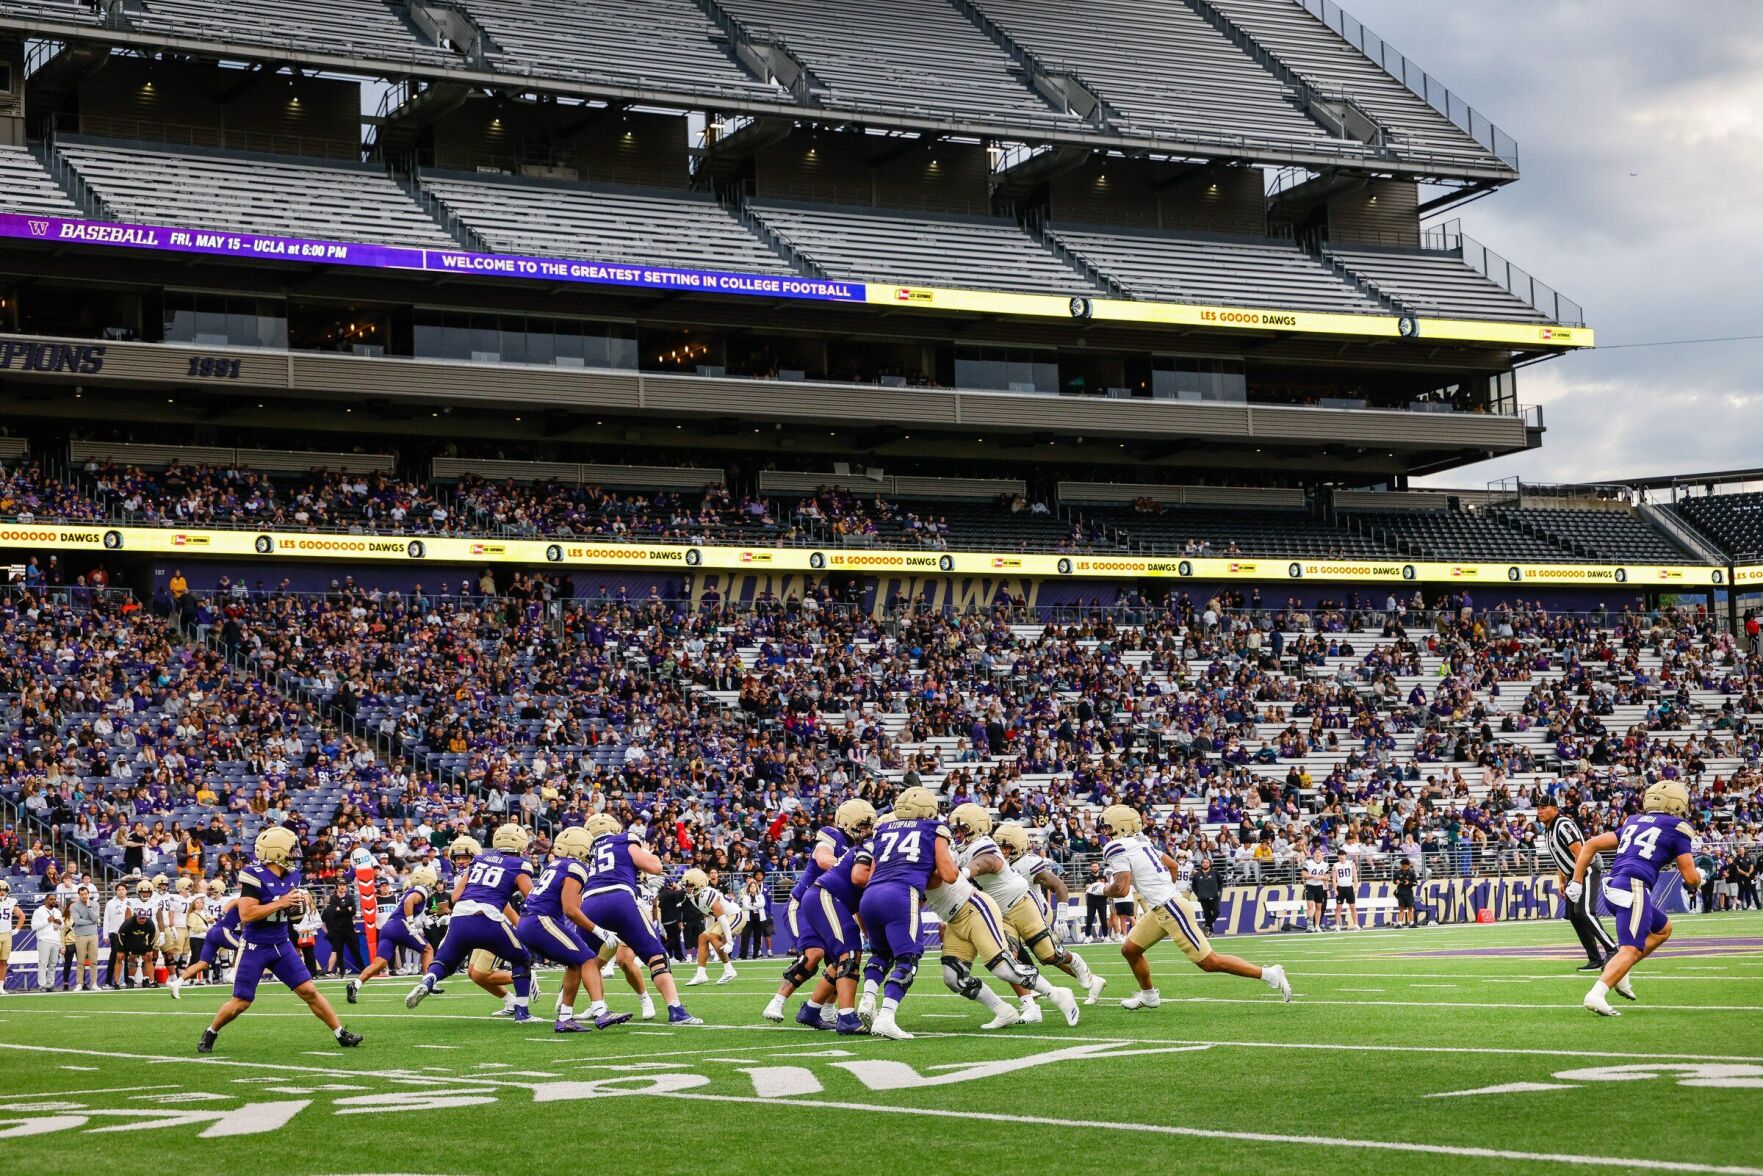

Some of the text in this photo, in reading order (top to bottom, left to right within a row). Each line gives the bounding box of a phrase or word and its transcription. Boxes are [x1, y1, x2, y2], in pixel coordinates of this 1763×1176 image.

[59, 223, 159, 245] BASEBALL
[170, 232, 192, 247] FRI,
[196, 235, 225, 249] MAY
[227, 238, 241, 250] 15
[254, 240, 285, 254] UCLA
[288, 244, 300, 254] at
[302, 244, 325, 257] 6:00
[327, 246, 348, 258] PM
[442, 255, 851, 297] WELCOME TO THE GREATEST SETTING IN COLLEGE FOOTBALL
[1201, 311, 1296, 326] LES GOOOO DAWGS
[0, 341, 106, 373] PIONS
[187, 356, 241, 378] 1991
[60, 533, 100, 543] DAWGS
[280, 540, 295, 549] LES
[369, 543, 404, 552] DAWGS
[567, 549, 583, 557] LES
[649, 551, 682, 560] DAWGS
[830, 556, 844, 564] LES
[906, 557, 937, 566] DAWGS
[1077, 562, 1089, 570] LES
[1148, 563, 1176, 571] DAWGS
[1306, 566, 1318, 574] LES
[1373, 567, 1400, 575] DAWGS
[877, 831, 922, 863] 74
[1617, 824, 1662, 860] 84
[1337, 867, 1351, 878] 80
[530, 868, 557, 897] 9
[0, 908, 11, 921] 5
